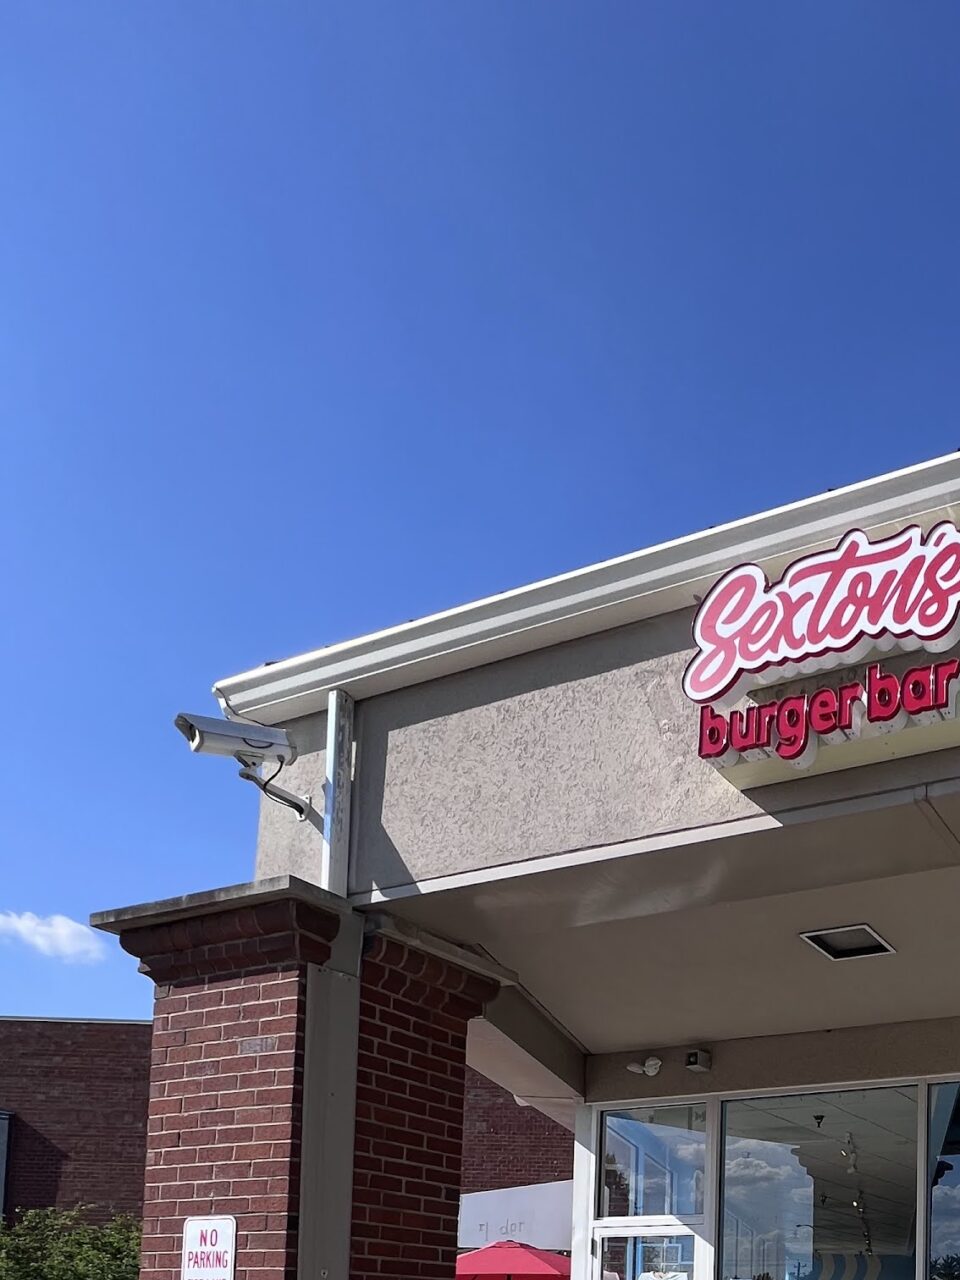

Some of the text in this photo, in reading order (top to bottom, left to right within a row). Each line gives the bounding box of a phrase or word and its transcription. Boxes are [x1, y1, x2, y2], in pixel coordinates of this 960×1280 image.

[699, 657, 960, 760] burger bar
[199, 1228, 218, 1247] NO
[187, 1249, 229, 1269] PARKING
